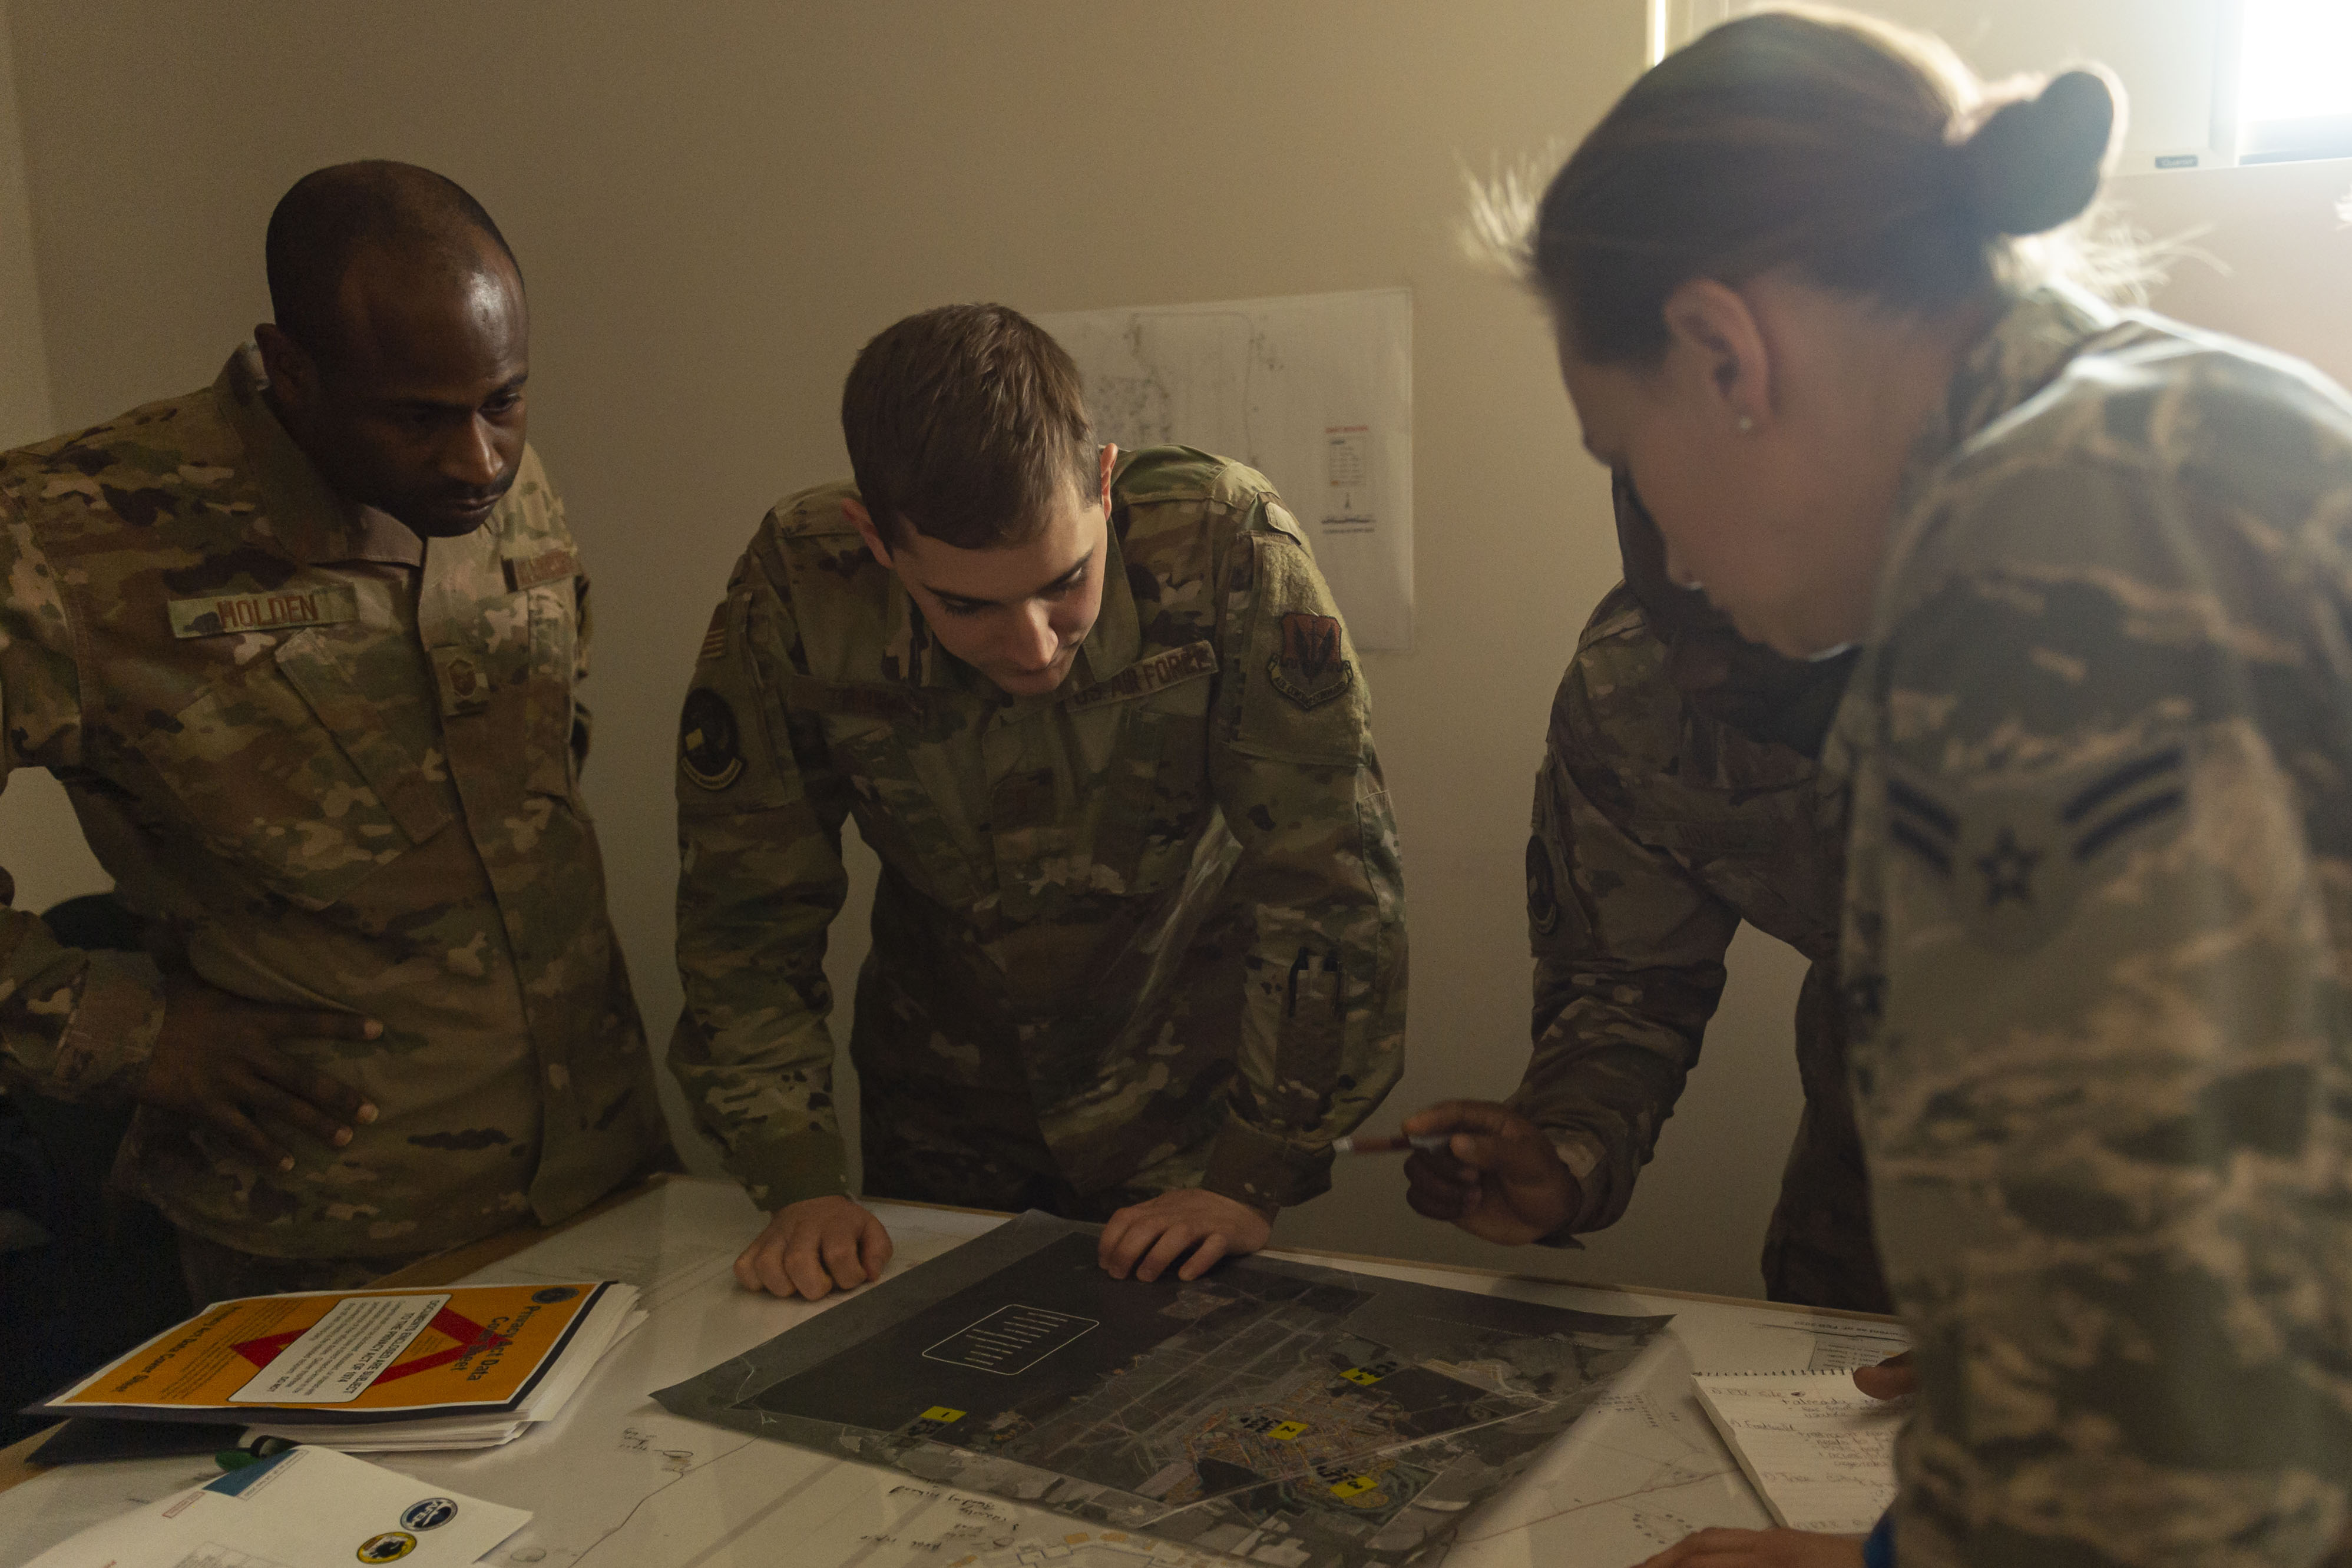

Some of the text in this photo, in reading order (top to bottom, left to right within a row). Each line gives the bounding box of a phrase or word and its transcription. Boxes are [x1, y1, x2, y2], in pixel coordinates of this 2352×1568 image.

[216, 594, 319, 628] HOLDEN
[1143, 647, 1212, 689] FORCE
[391, 1320, 407, 1330] THE
[371, 1331, 398, 1351] PRIVACY
[378, 1331, 412, 1358] ENCLOSED
[466, 1305, 541, 1381] Privacy Act Data
[353, 1362, 365, 1371] OF
[358, 1352, 376, 1362] ACT
[366, 1359, 386, 1370] ARE
[450, 1344, 488, 1371] Sheet
[337, 1371, 356, 1382] 1974
[343, 1371, 375, 1394] SUBJECT
[1347, 1481, 1364, 1490] 3
